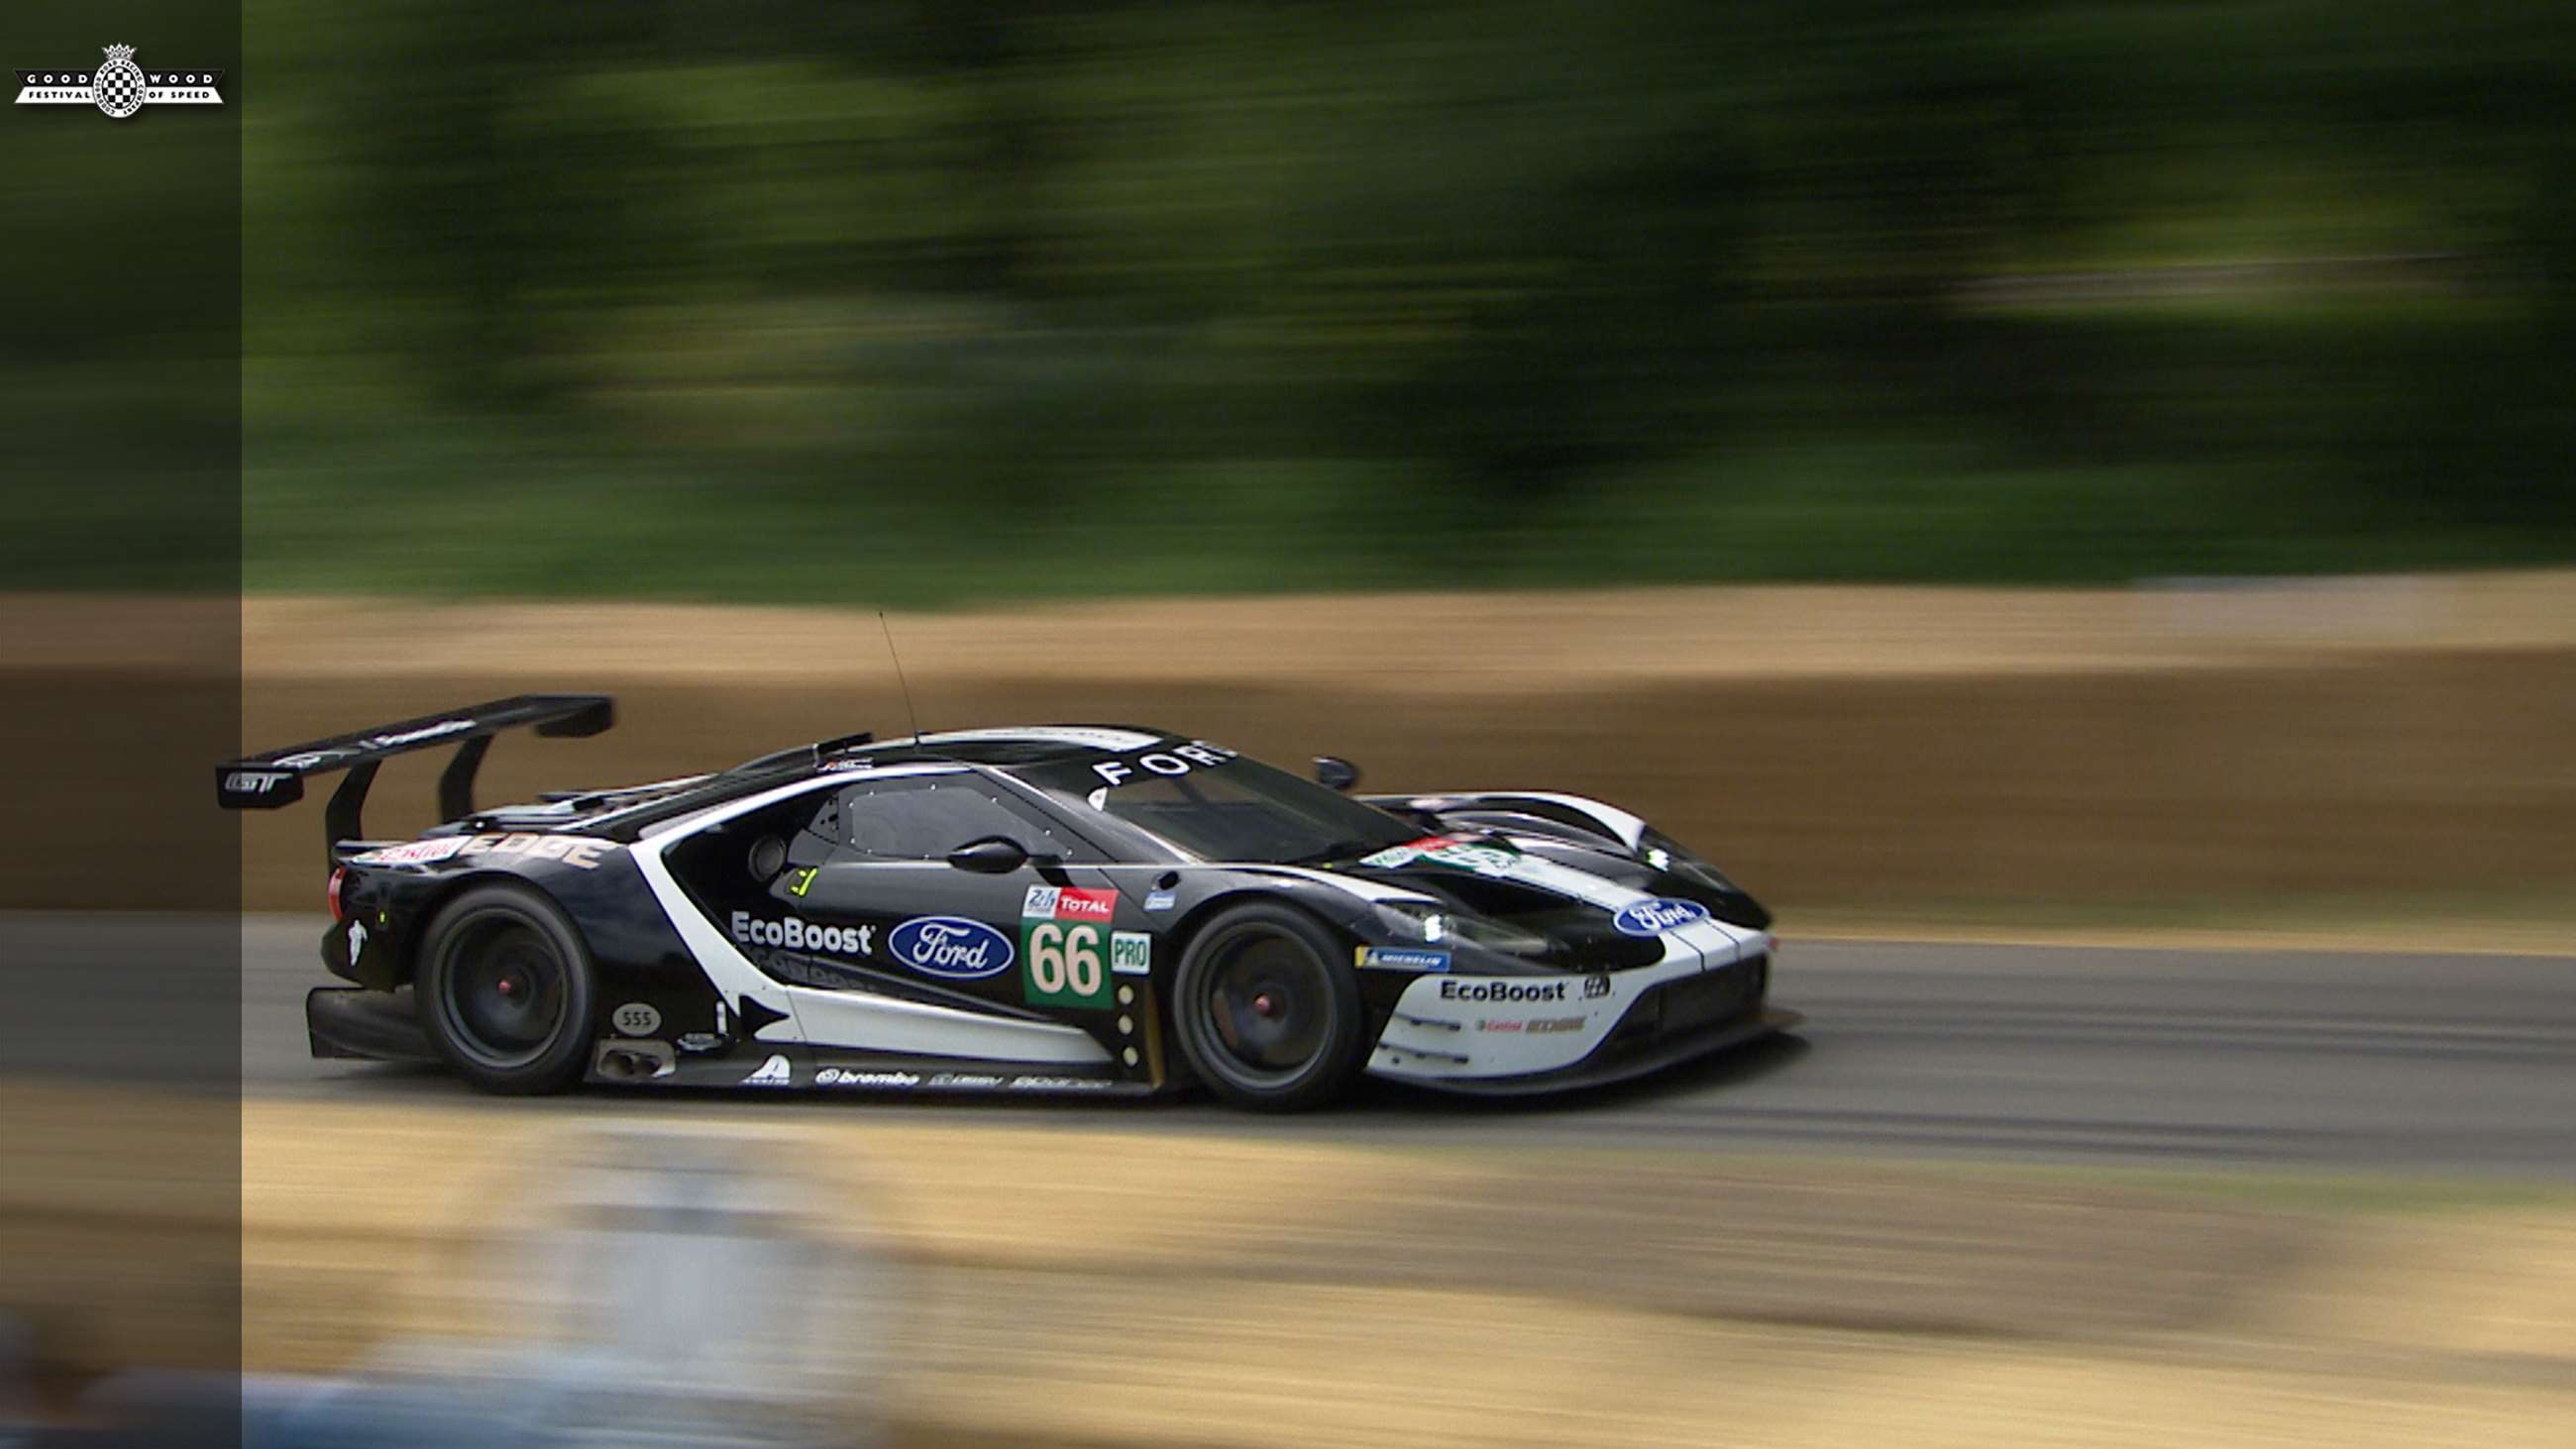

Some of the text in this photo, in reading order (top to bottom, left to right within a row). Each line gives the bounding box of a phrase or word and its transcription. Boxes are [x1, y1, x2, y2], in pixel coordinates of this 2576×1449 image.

[457, 832, 605, 870] EDGE
[731, 911, 873, 956] EcoBoost
[912, 923, 989, 969] Ford
[1029, 922, 1102, 996] 66
[1114, 939, 1146, 967] PRO
[1440, 980, 1564, 1001] EcoBoost
[622, 1010, 653, 1027] 555
[838, 1071, 919, 1086] brembo
